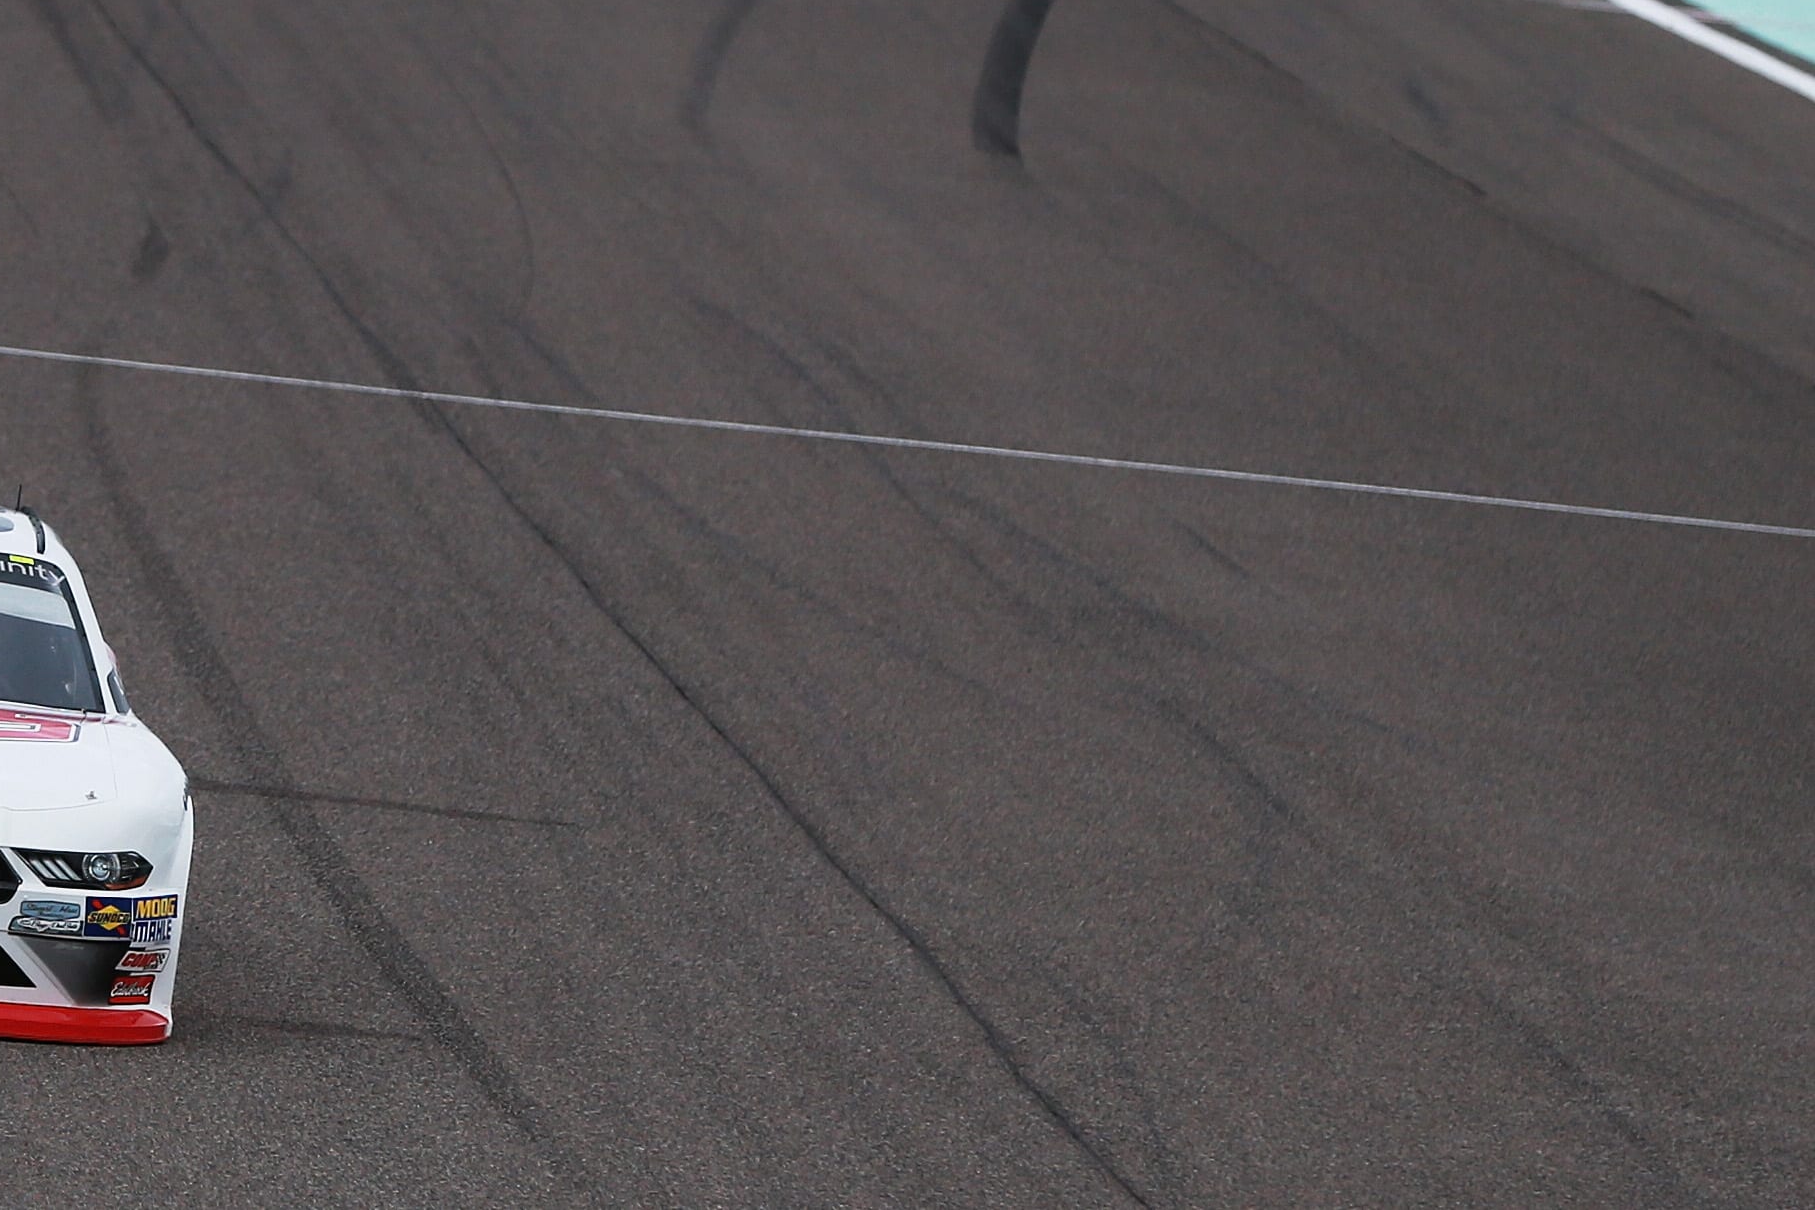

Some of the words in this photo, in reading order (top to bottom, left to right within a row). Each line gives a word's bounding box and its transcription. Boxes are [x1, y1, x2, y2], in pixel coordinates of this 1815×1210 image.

[87, 910, 132, 924] SUNOCO
[135, 896, 177, 919] MOOG
[134, 918, 172, 943] MAHLE
[109, 979, 149, 998] Edelbrock
